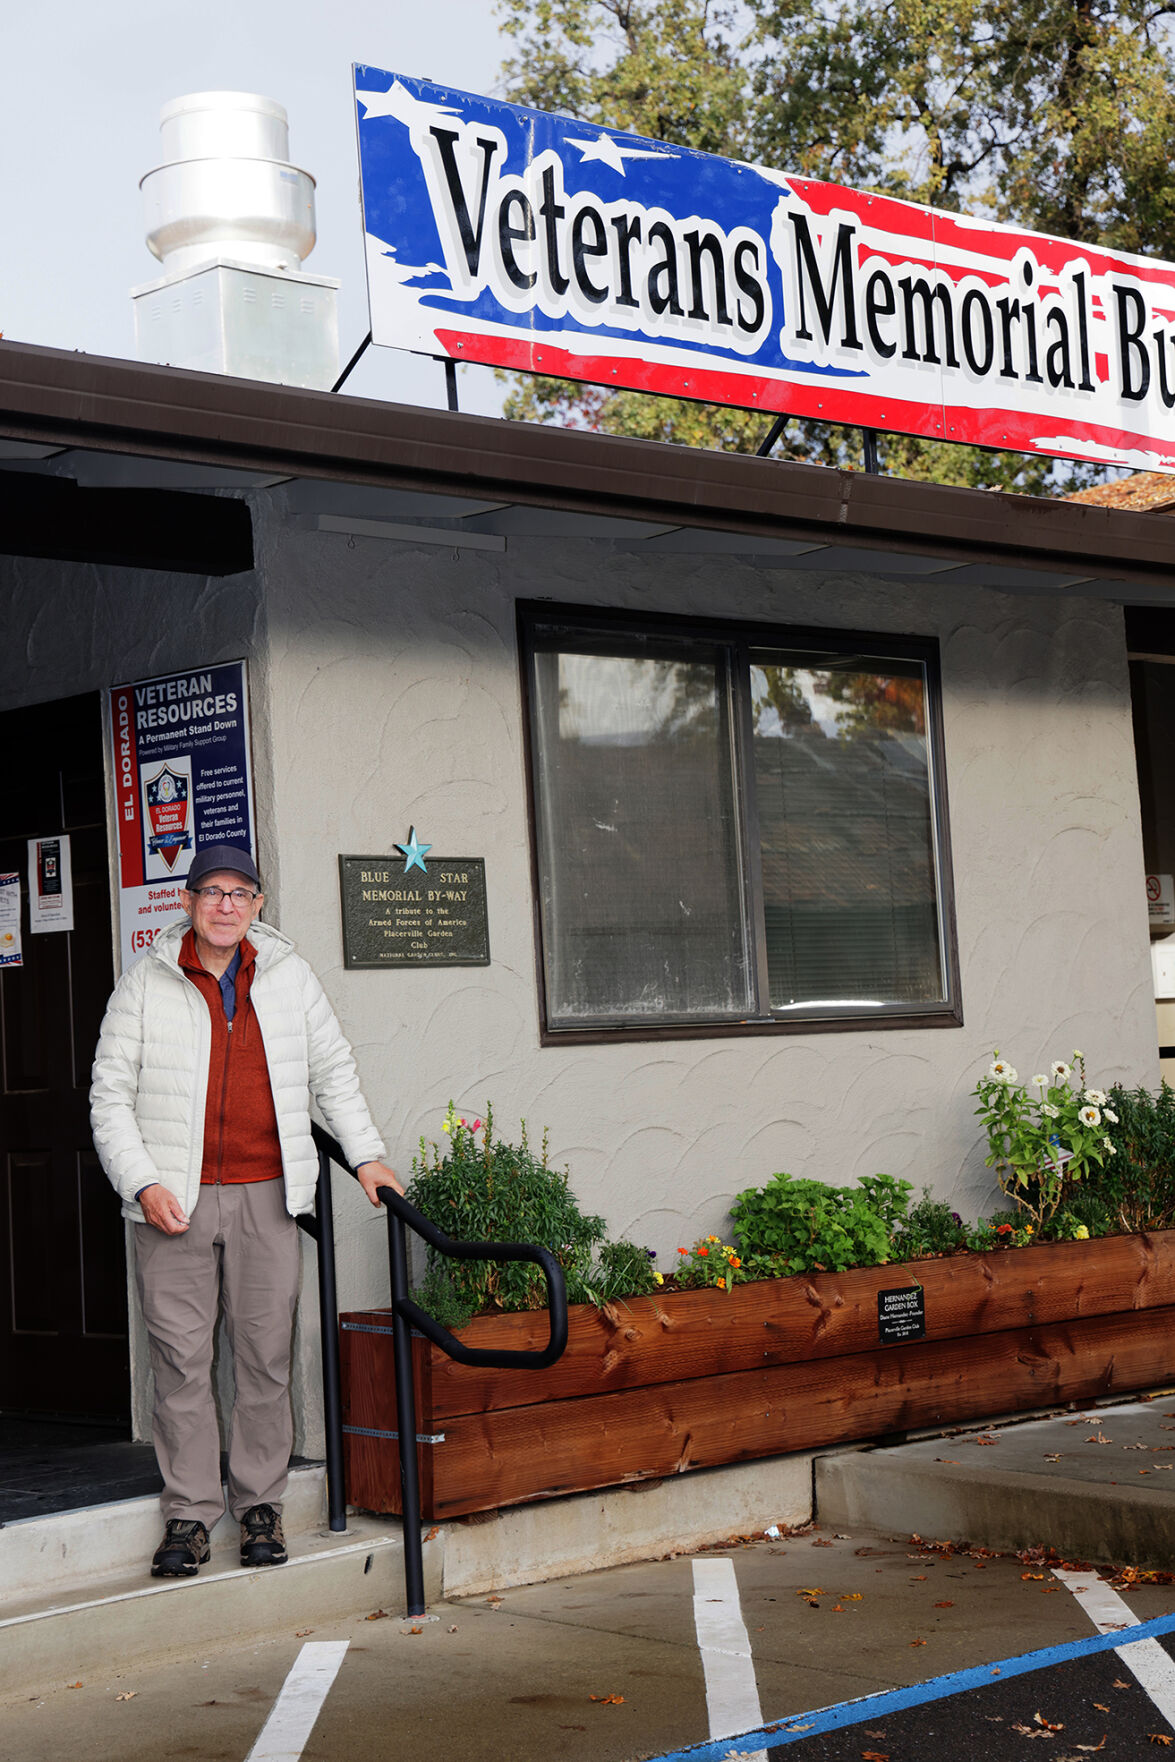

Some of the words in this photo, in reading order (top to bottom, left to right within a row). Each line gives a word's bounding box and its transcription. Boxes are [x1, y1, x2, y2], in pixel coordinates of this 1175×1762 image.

[428, 125, 763, 334] Veterans
[787, 211, 1096, 393] Memorial
[135, 674, 212, 706] VETERAN
[136, 692, 238, 730] RESOURCES
[138, 736, 144, 745] A
[146, 728, 187, 744] Permanent
[189, 722, 212, 736] Stand
[214, 719, 237, 732] Down
[118, 696, 132, 788] DORADO
[194, 738, 212, 746] Support
[200, 769, 213, 777] Free
[214, 766, 238, 775] services
[196, 781, 216, 790] offered
[223, 777, 244, 786] current
[196, 795, 216, 804] military
[216, 789, 246, 802] personnel,
[124, 794, 134, 821] EL
[204, 806, 227, 815] veterans
[228, 803, 239, 812] and
[200, 820, 214, 828] their
[214, 817, 236, 826] families
[206, 832, 225, 841] Dorado
[226, 829, 246, 838] County
[361, 872, 389, 883] BLUE
[440, 873, 468, 883] STAR
[148, 888, 175, 900] Staffed
[362, 890, 422, 901] MEMORIAL
[428, 890, 467, 901] BY-WAY
[138, 905, 152, 914] and
[154, 902, 184, 912] volunte
[884, 1292, 917, 1303] HERNANDEZ
[885, 1303, 906, 1312] GARDEN
[907, 1301, 918, 1309] BOX
